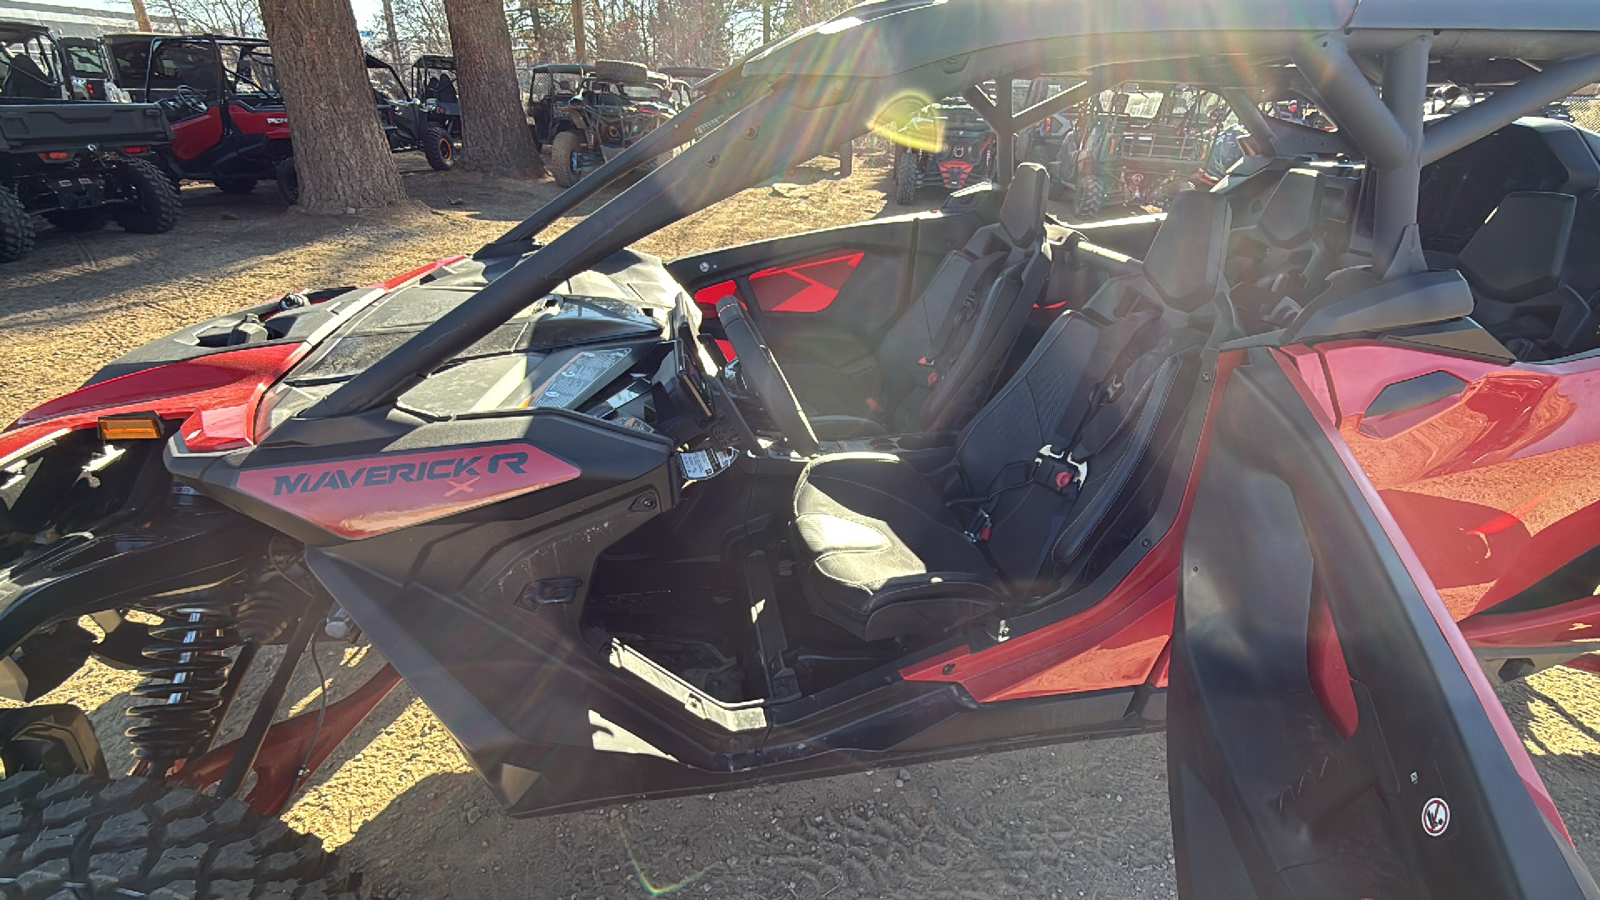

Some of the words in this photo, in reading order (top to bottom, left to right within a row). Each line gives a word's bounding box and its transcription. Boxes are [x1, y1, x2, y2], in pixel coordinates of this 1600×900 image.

[273, 456, 484, 496] MAVERICK
[488, 451, 529, 474] R
[443, 476, 481, 497] X
